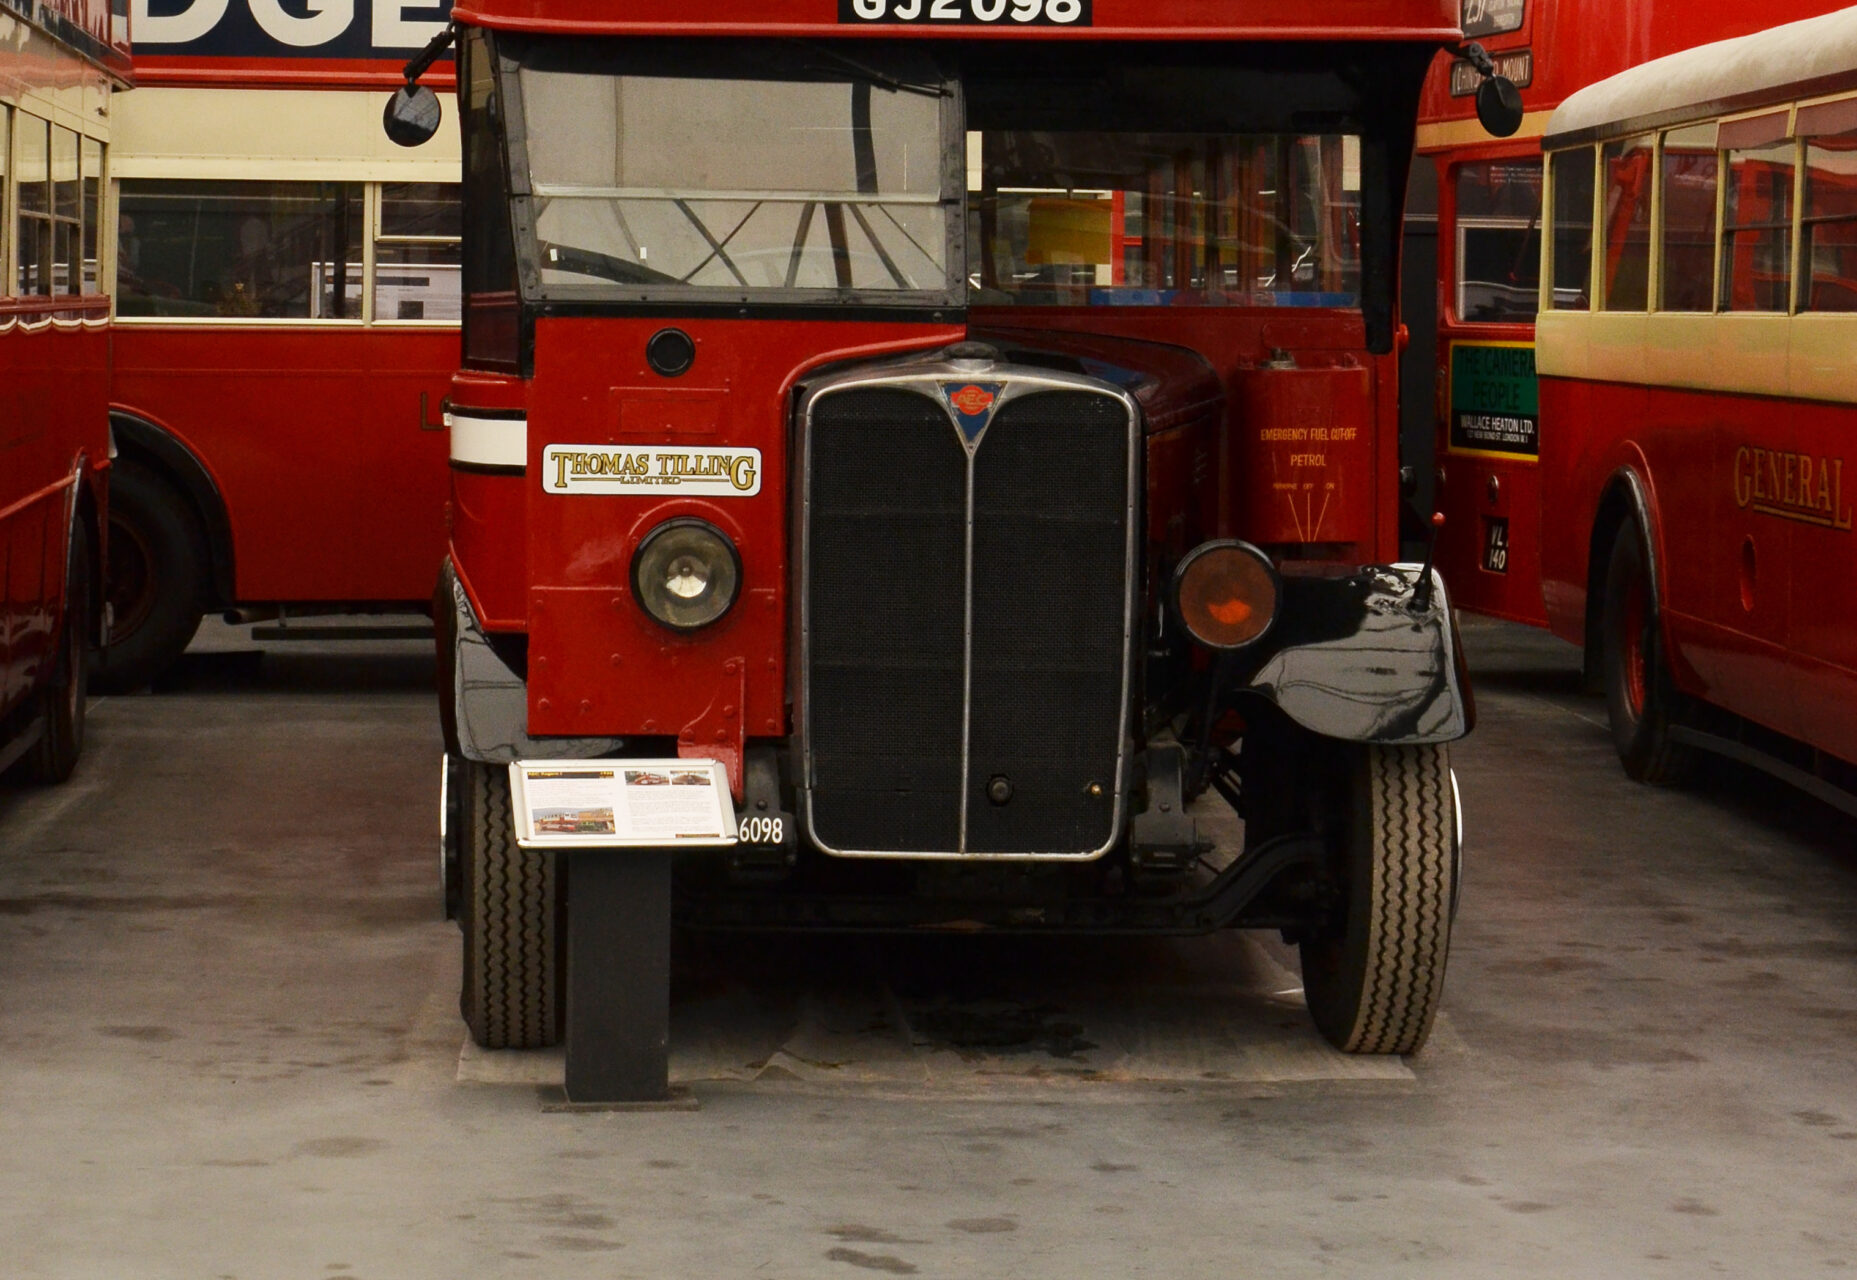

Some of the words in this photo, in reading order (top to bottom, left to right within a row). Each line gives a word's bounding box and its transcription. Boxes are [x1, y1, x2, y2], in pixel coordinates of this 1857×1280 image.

[1473, 381, 1520, 410] PEOPLE
[1261, 428, 1308, 440] EMERGENCY
[1310, 427, 1329, 440] FUEL
[1461, 415, 1490, 430] WALLACE
[1492, 417, 1518, 432] HEATON
[551, 452, 649, 488] THOMAS
[656, 454, 756, 490] TILLING
[1290, 454, 1327, 467] PETROL
[619, 476, 682, 485] LIMITED
[1734, 446, 1852, 529] GENERAL
[739, 817, 783, 844] 6098
